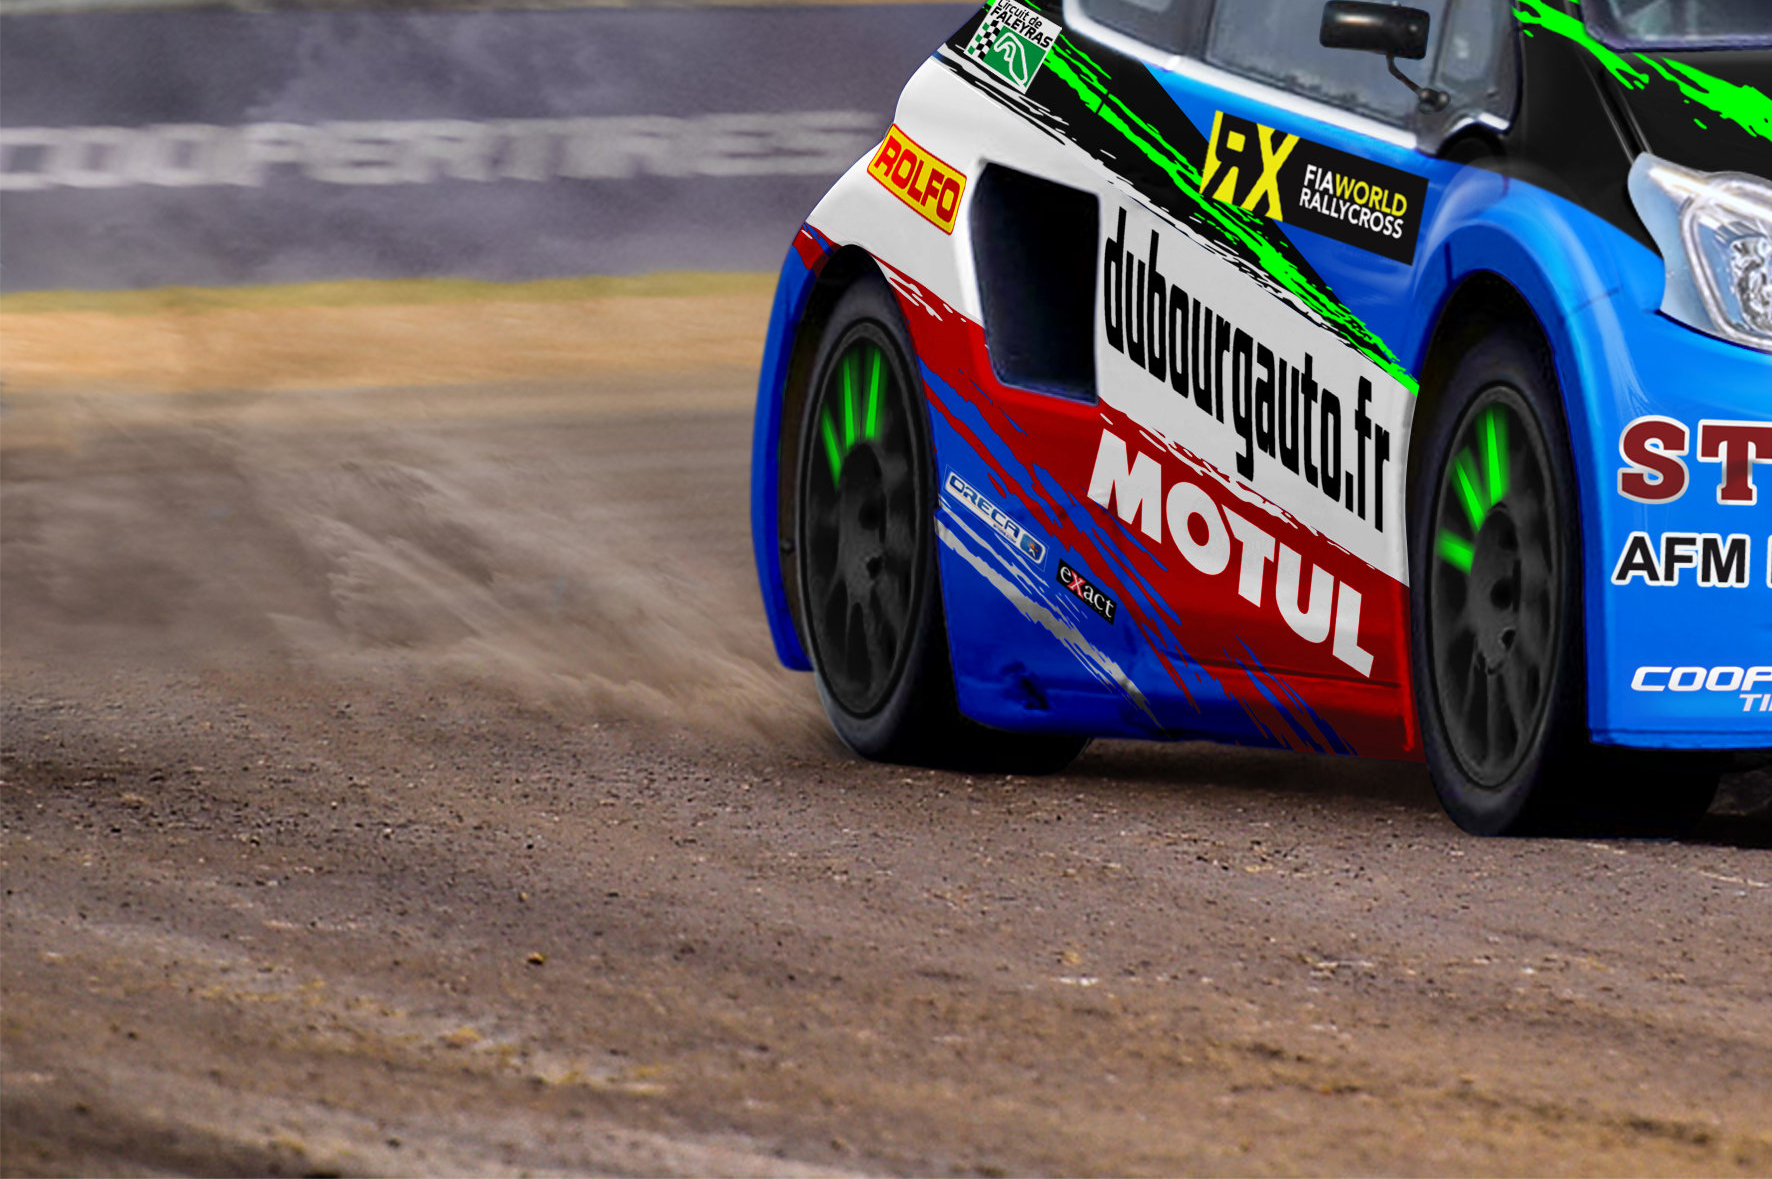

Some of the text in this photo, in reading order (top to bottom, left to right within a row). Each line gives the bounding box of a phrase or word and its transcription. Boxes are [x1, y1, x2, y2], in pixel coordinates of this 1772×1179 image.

[990, 7, 1054, 48] FALEYRAS
[1029, 17, 1042, 29] de
[873, 135, 961, 223] ROLFO
[1199, 110, 1300, 222] RX
[1299, 187, 1404, 239] RALLYCROSS
[1103, 206, 1390, 533] dubourgauto.fr
[949, 475, 1022, 539] ORECA
[1087, 428, 1374, 679] MOTUL
[1614, 535, 1748, 584] AFM
